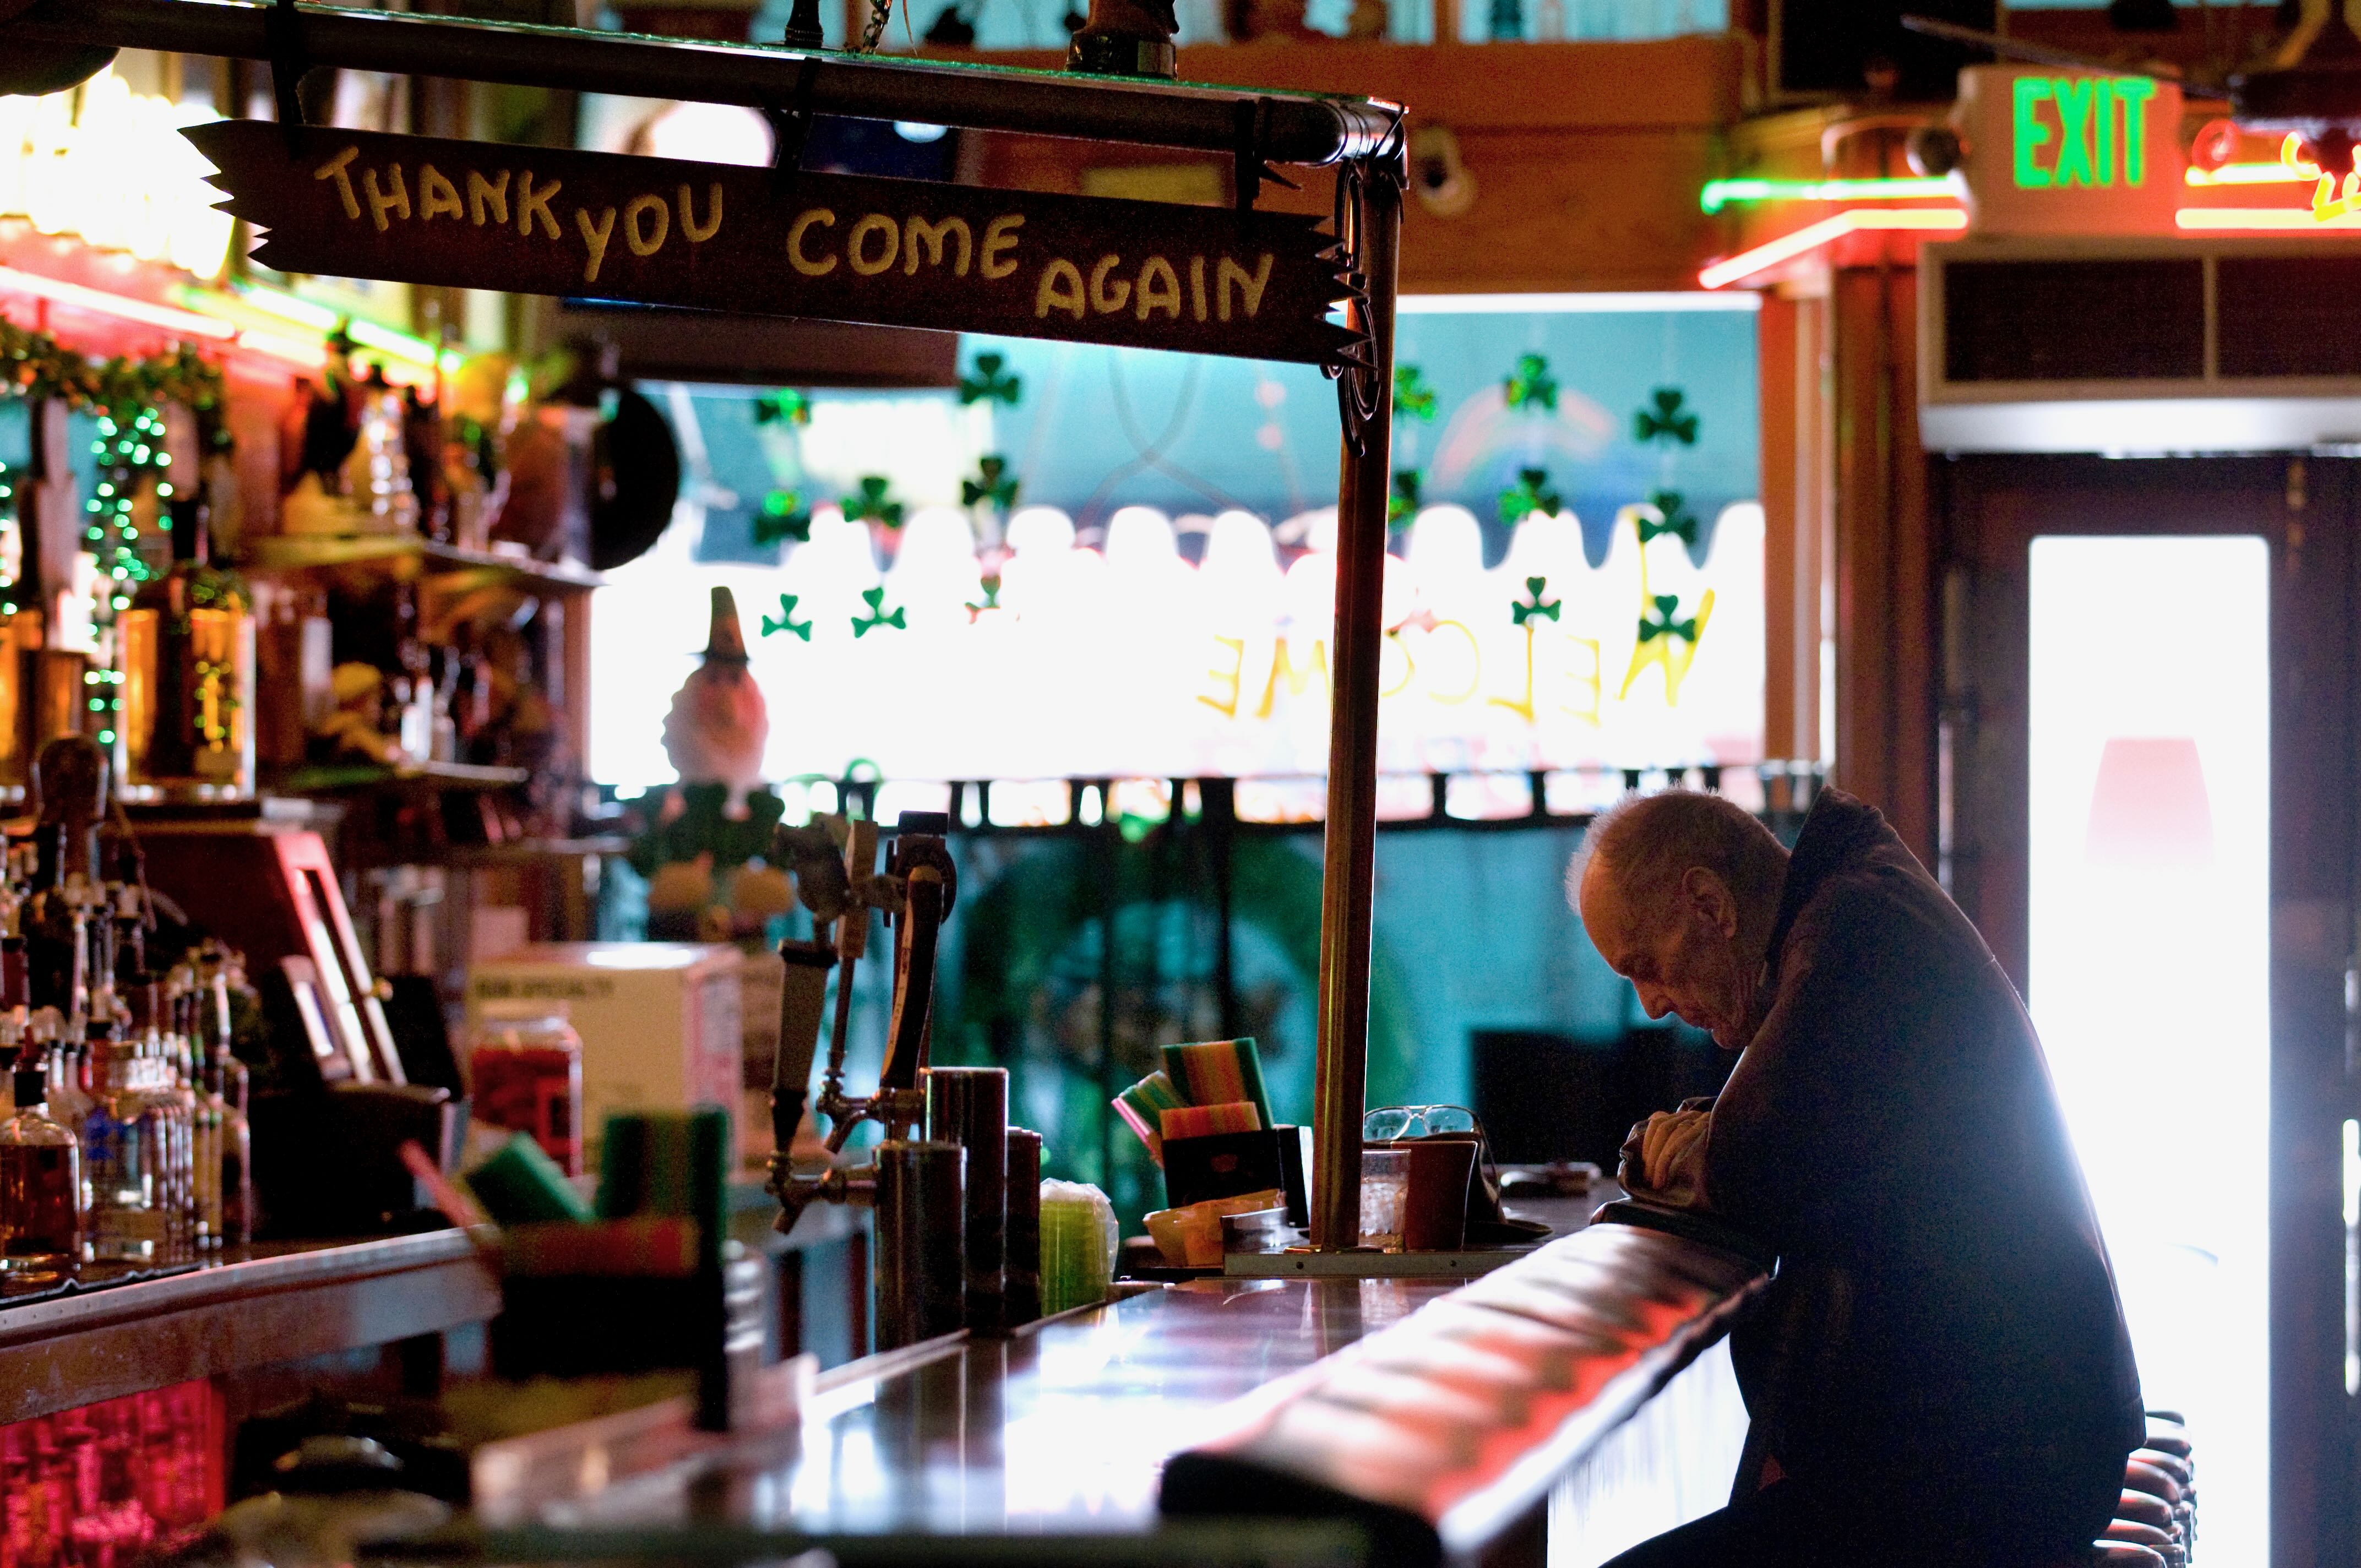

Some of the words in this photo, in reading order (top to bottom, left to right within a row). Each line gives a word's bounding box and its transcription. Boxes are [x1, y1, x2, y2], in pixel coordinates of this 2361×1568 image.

[2013, 78, 2156, 187] EXIT
[313, 144, 562, 240] THANK
[786, 208, 1025, 279] COME
[1034, 253, 1275, 322] AGAIN
